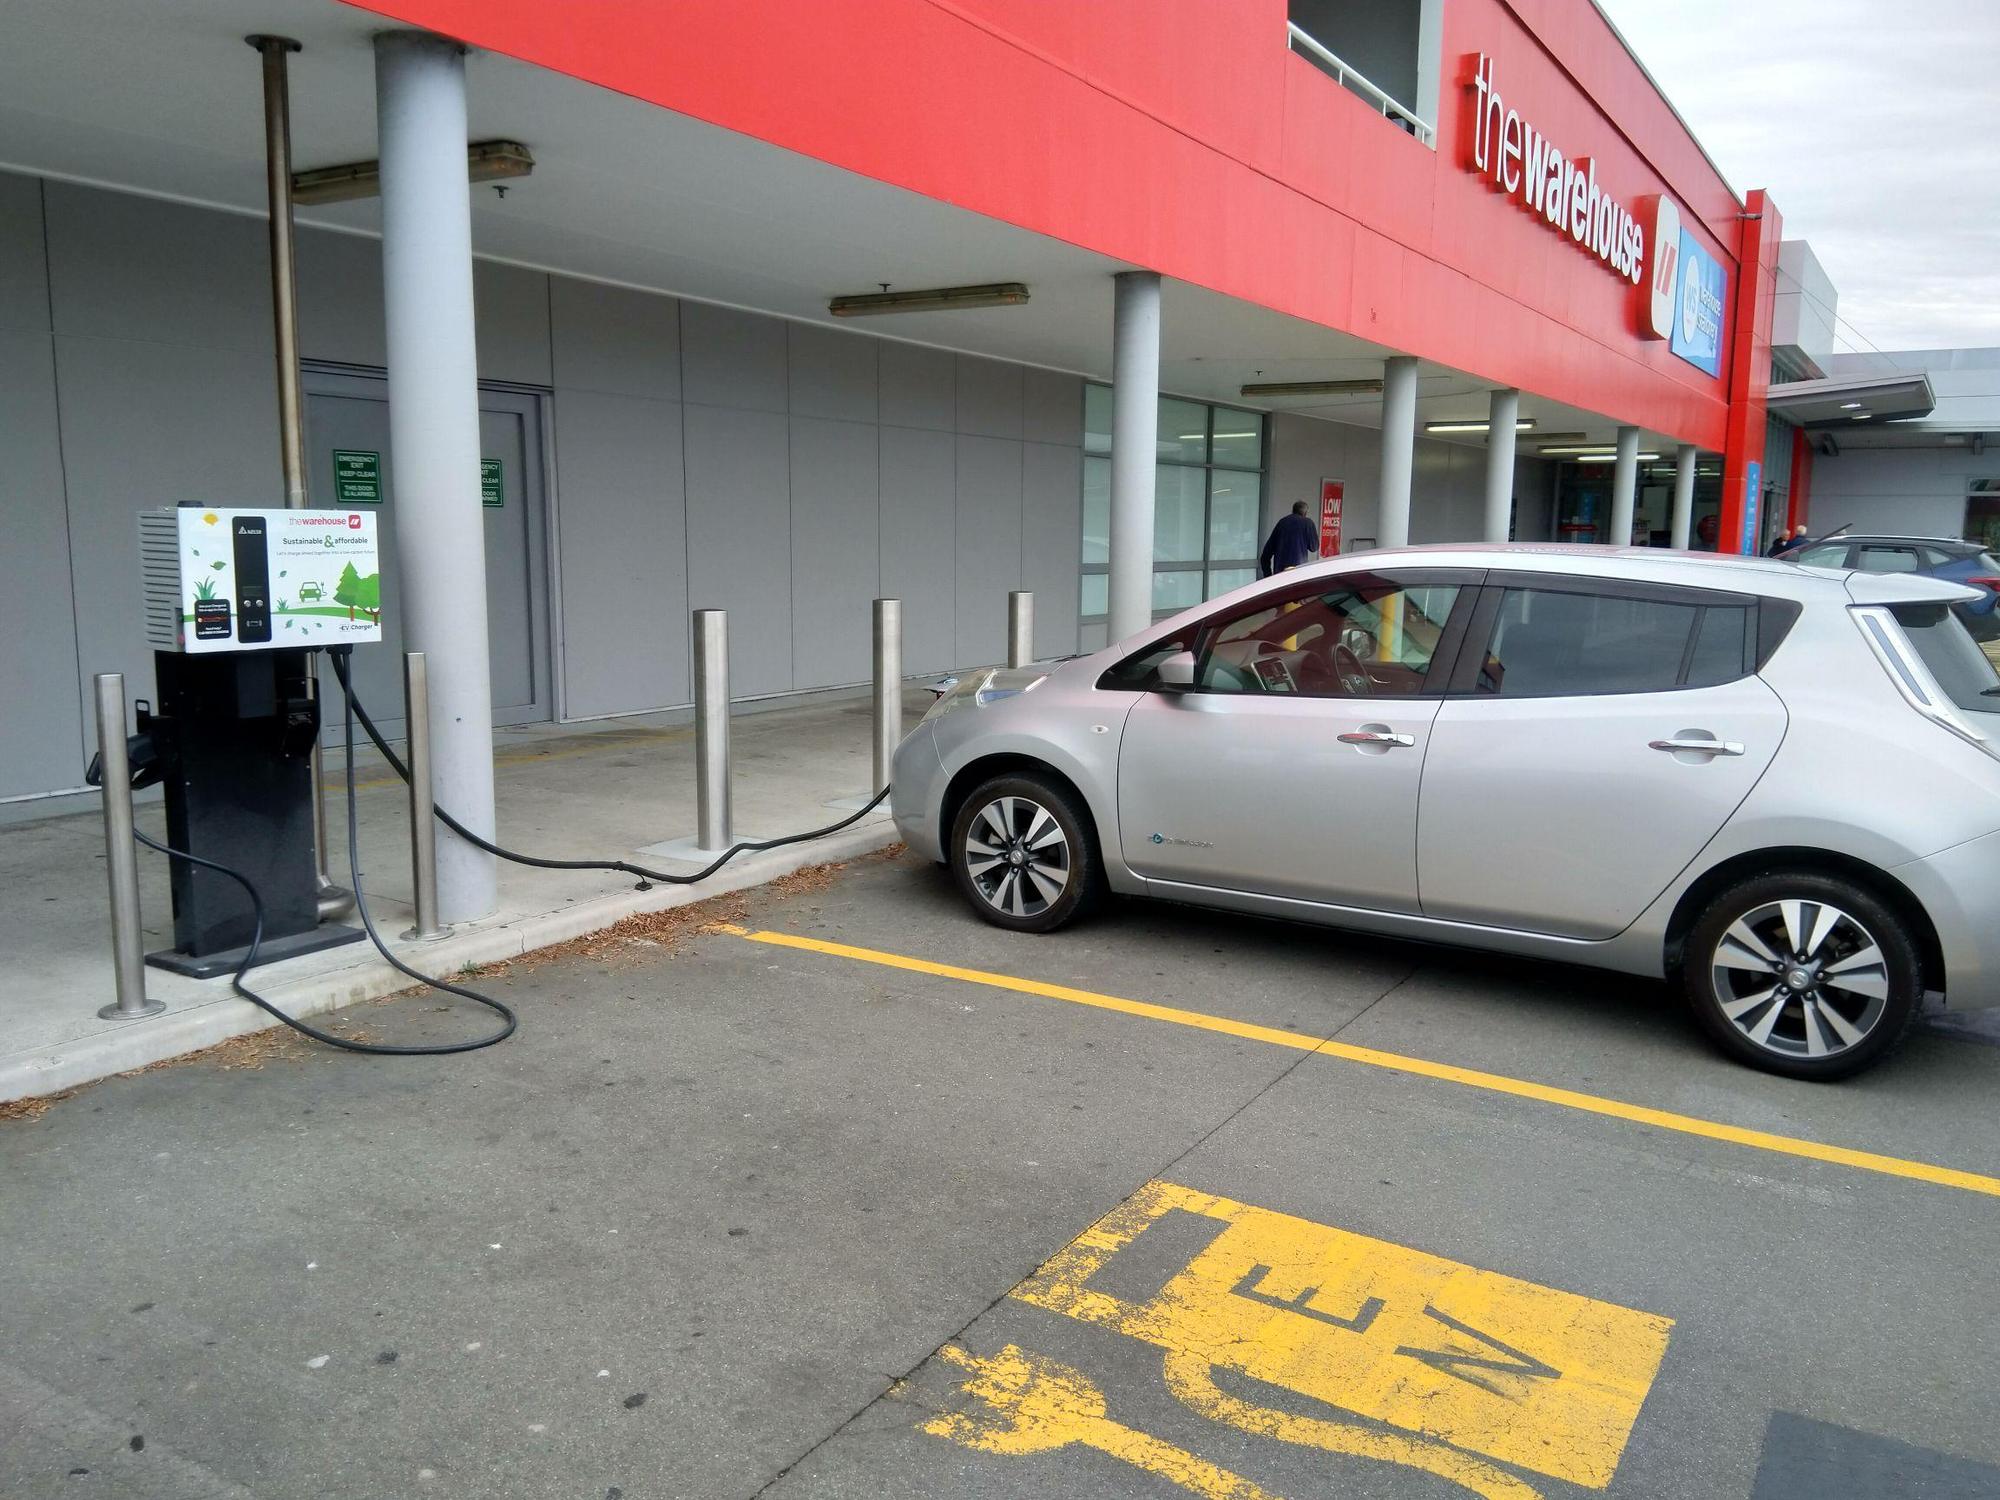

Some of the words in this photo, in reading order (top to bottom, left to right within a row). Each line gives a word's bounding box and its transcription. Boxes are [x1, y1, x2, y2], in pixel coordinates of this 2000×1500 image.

[1324, 499, 1341, 514] LOW
[1323, 517, 1340, 527] PRICES
[282, 537, 323, 545] Sustainable
[324, 534, 335, 548] &
[335, 536, 368, 544] affordable
